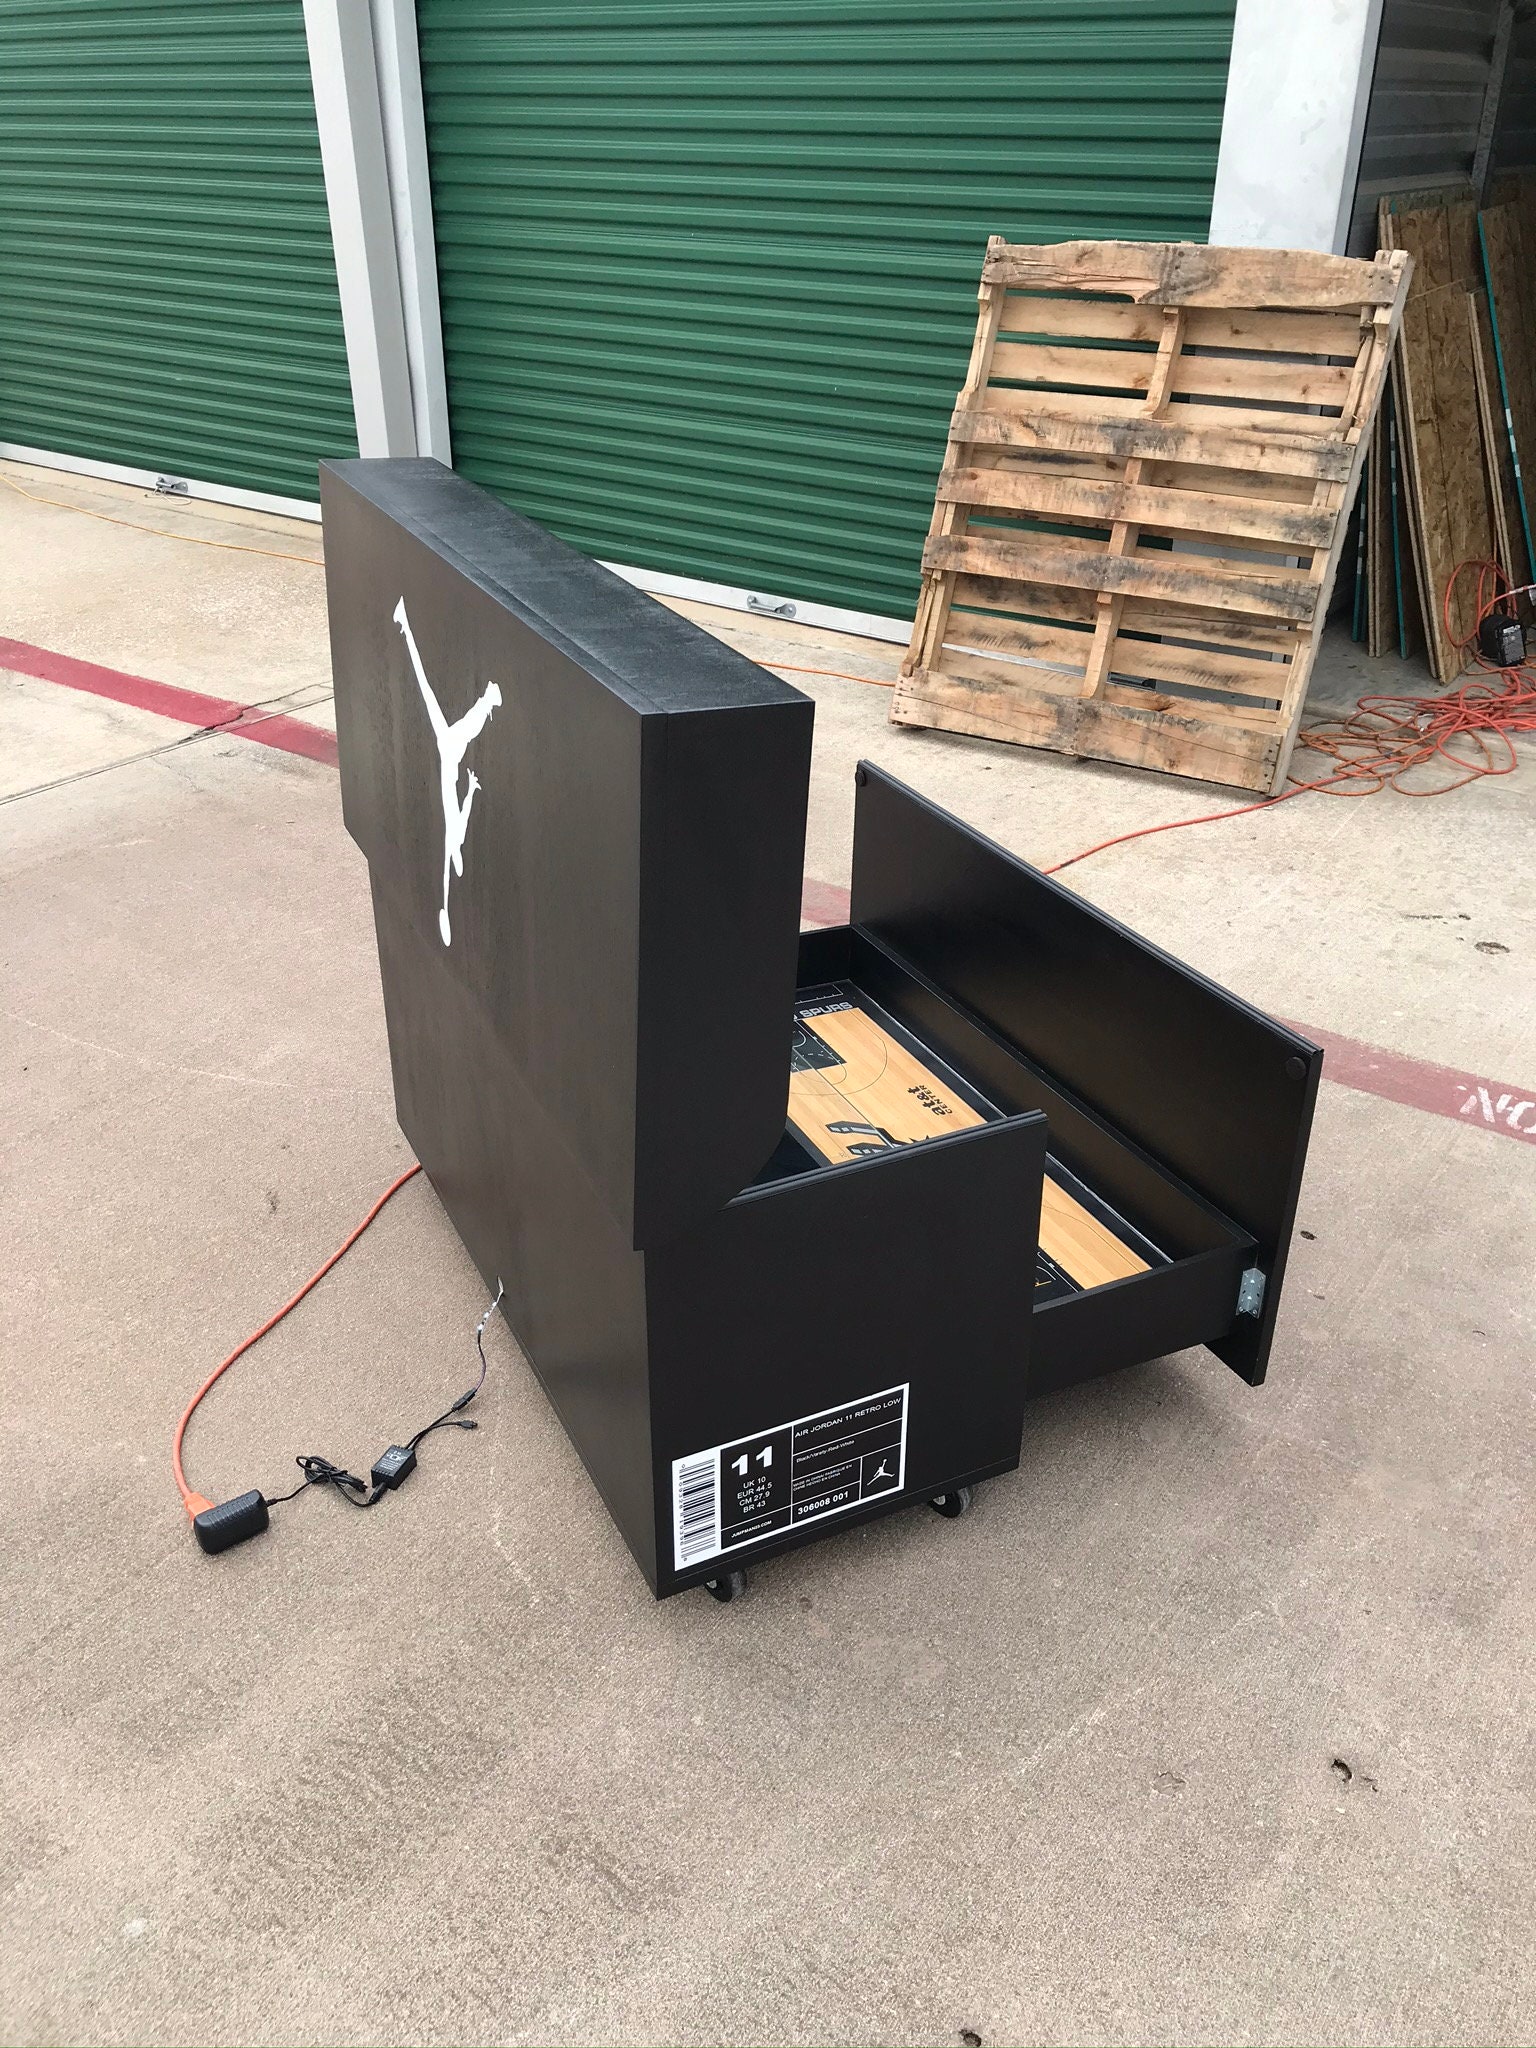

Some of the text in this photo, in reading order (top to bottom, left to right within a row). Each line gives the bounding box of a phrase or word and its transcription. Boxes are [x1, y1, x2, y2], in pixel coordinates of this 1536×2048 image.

[799, 1001, 853, 1017] SPURS
[918, 1083, 953, 1115] CENTER
[795, 1397, 902, 1438] AIR JORDAN 11 RETRO LOW
[731, 1445, 773, 1476] 11
[737, 1481, 773, 1499] EUR 44.5
[743, 1476, 767, 1489] UK 10
[739, 1496, 752, 1507] CM
[743, 1500, 766, 1513] BR 43
[797, 1490, 850, 1515] 306008 001
